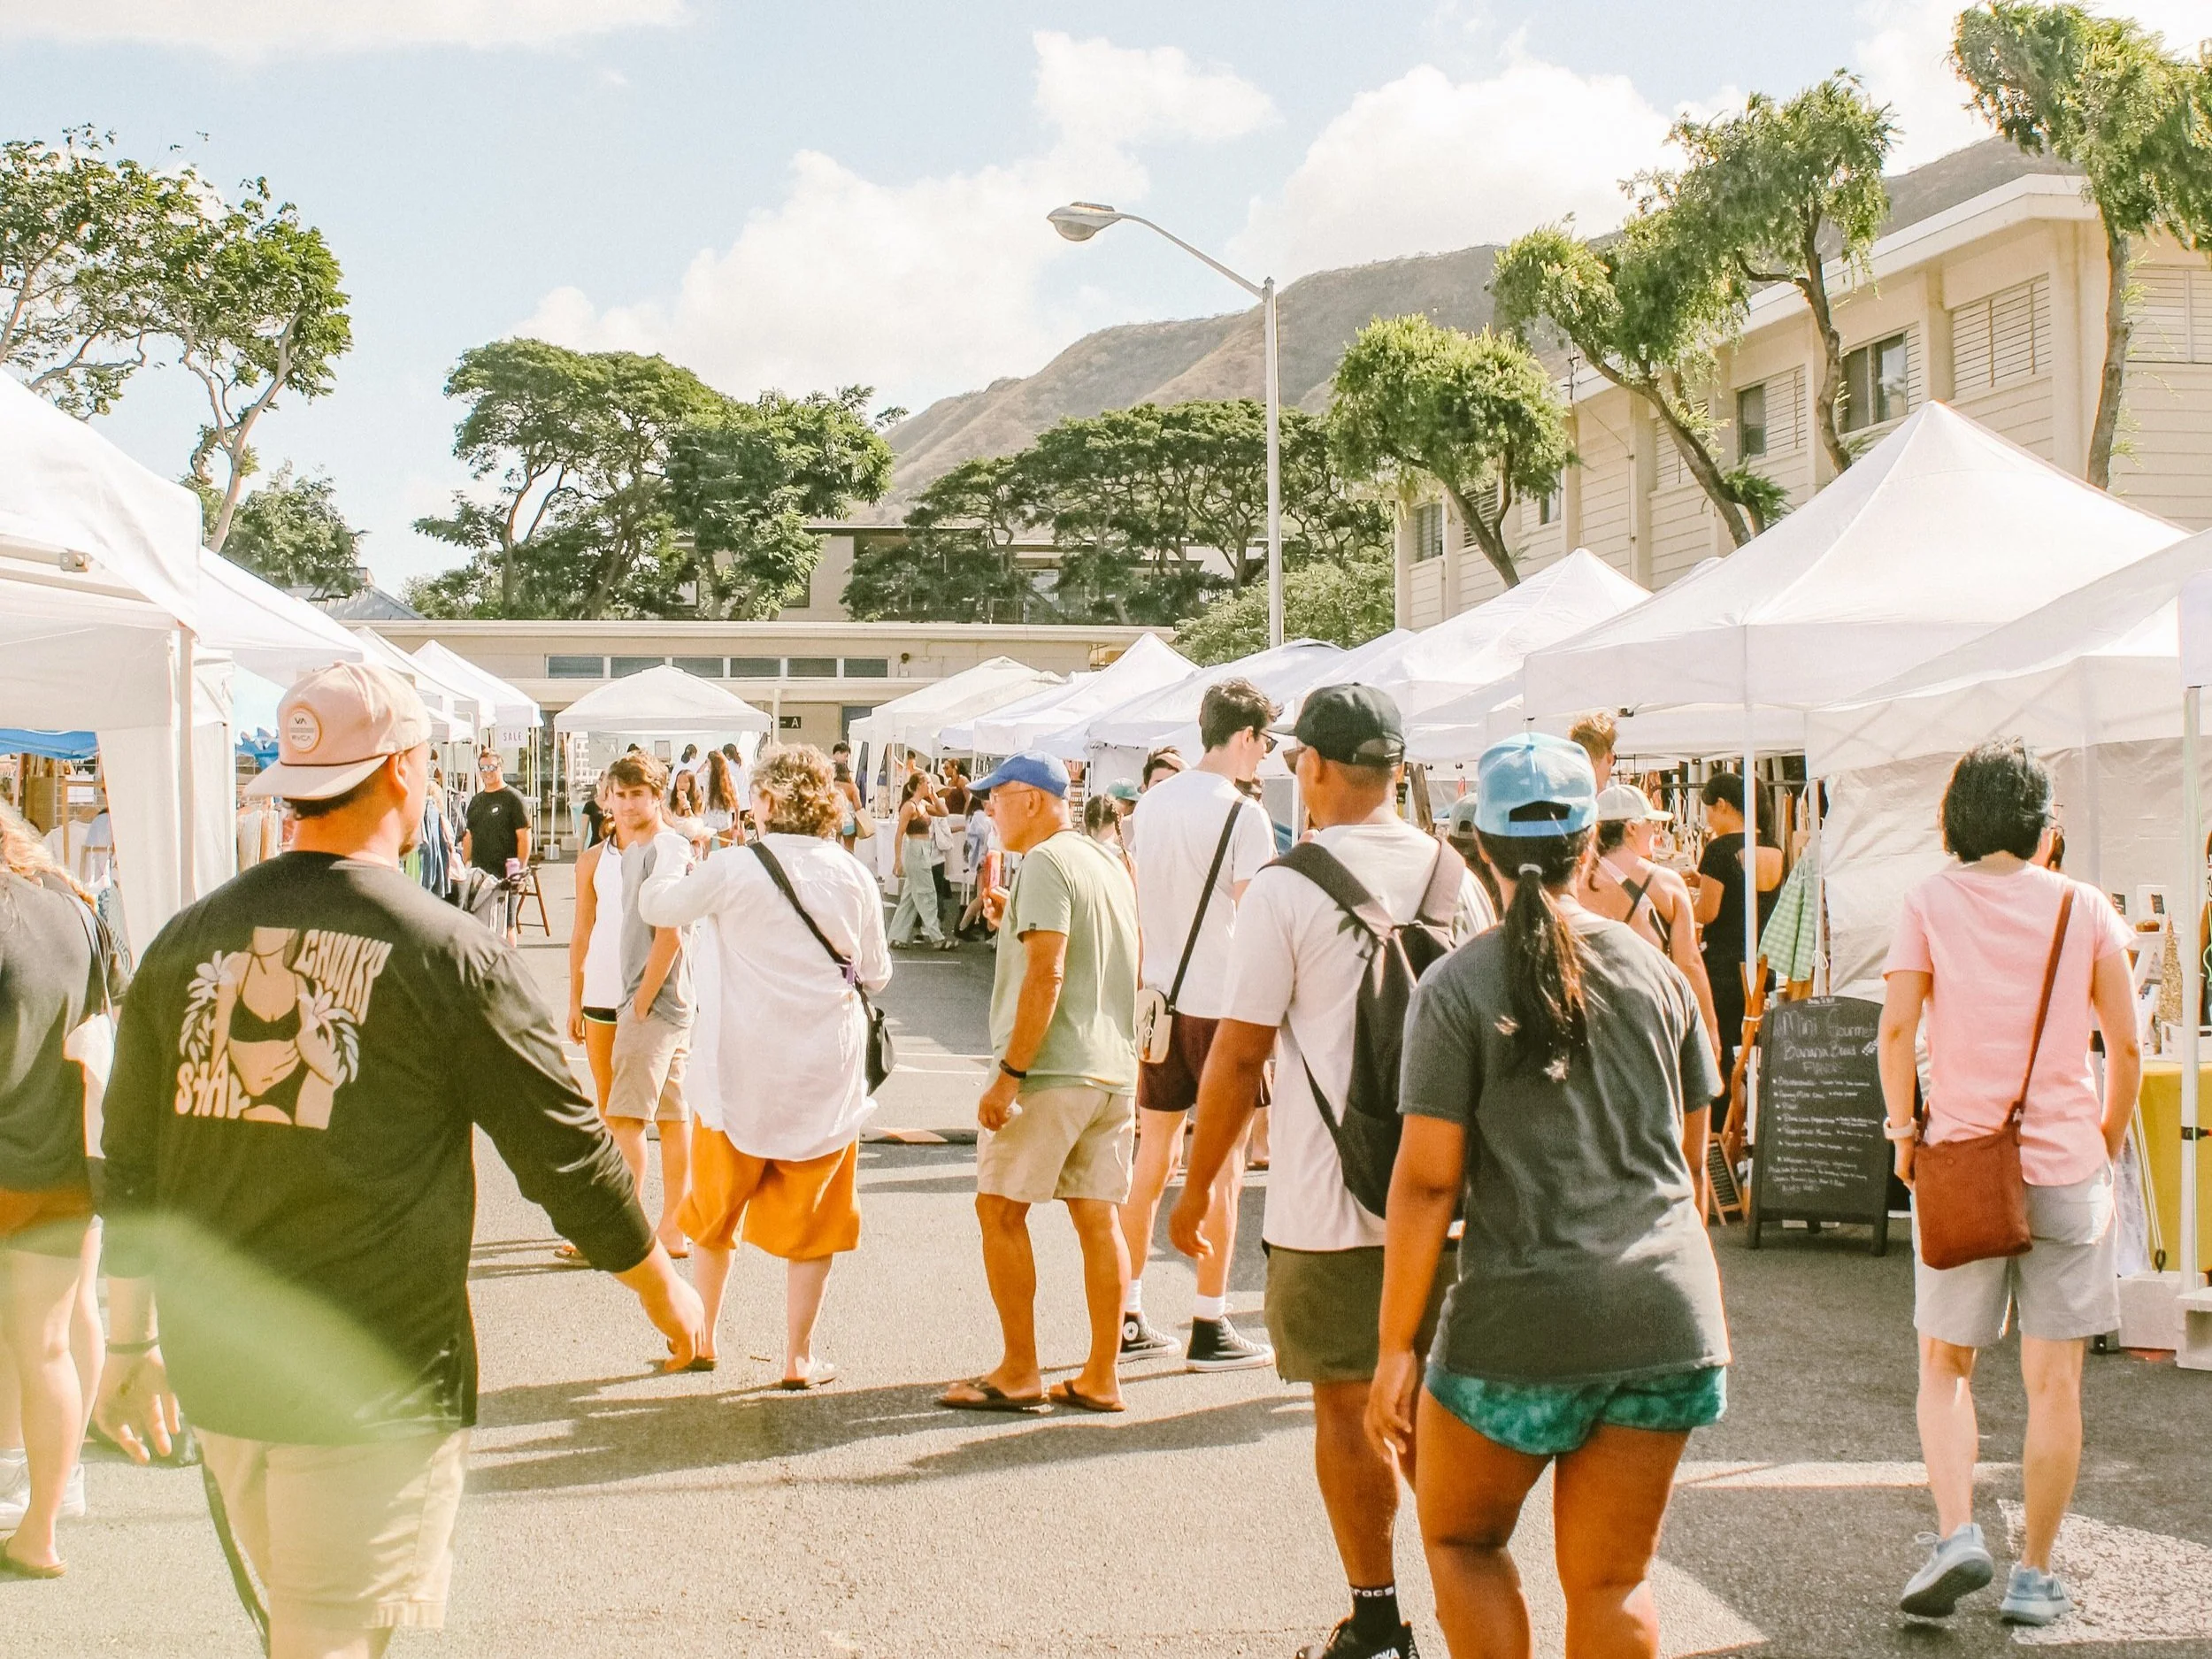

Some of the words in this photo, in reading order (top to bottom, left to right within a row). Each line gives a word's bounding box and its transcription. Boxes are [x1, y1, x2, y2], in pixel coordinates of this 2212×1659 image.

[791, 717, 799, 728] A
[503, 732, 522, 741] SALE
[293, 929, 393, 1026] CHUNKY
